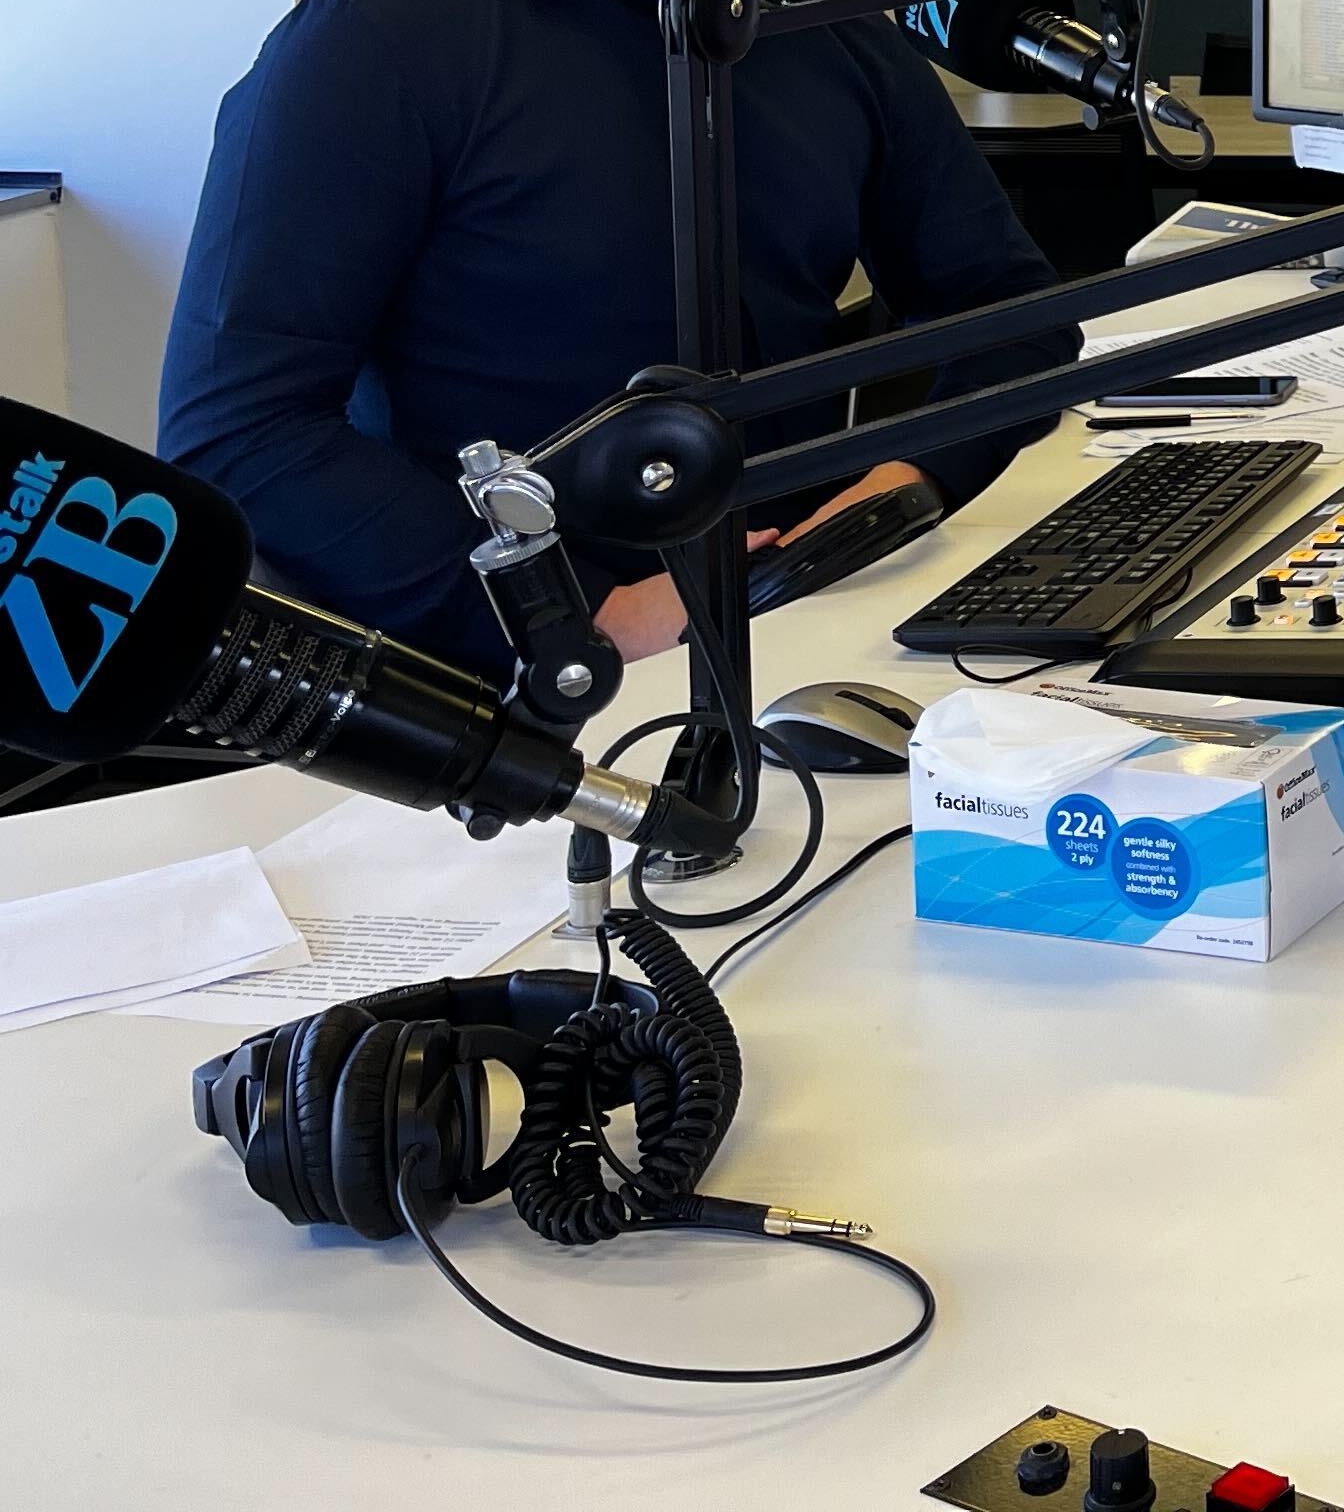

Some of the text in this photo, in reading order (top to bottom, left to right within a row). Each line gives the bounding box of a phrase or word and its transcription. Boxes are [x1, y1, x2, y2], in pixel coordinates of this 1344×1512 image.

[0, 476, 178, 713] ZB
[1056, 809, 1106, 840] 224
[1065, 840, 1099, 853] sheets
[1123, 836, 1177, 852] gentle silky
[1071, 852, 1095, 866] 2 ply
[1131, 849, 1170, 861] softness
[1125, 861, 1160, 872] combined
[1126, 872, 1177, 886] strength &
[1125, 883, 1179, 900] absorbency
